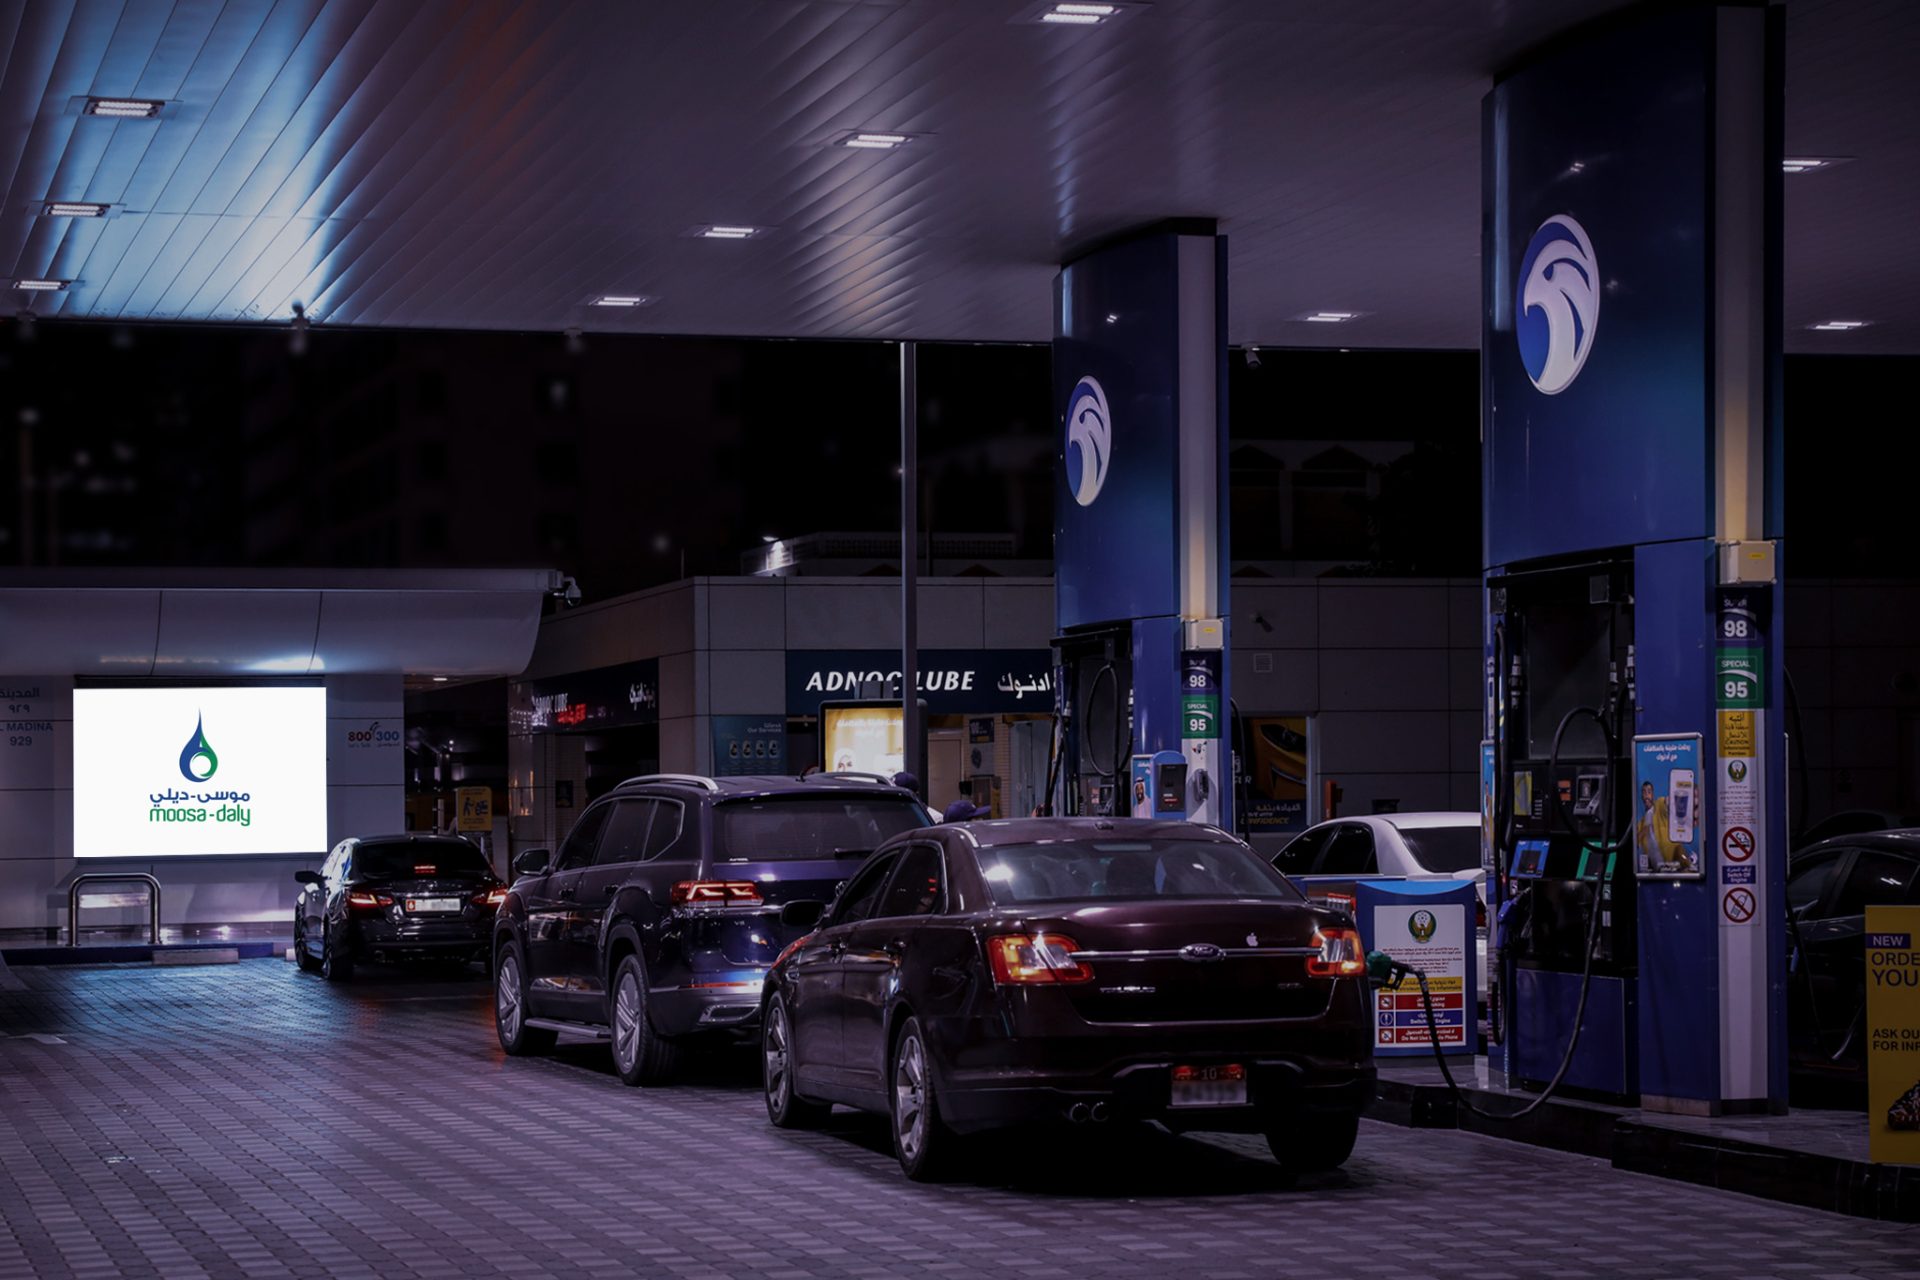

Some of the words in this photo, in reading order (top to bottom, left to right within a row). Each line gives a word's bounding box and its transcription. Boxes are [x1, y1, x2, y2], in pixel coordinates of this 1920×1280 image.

[1724, 620, 1748, 638] 98
[1721, 660, 1750, 668] SPECIAL
[997, 672, 1051, 700] ادنوك
[1189, 674, 1207, 688] 98
[1724, 681, 1748, 699] 95
[7, 722, 53, 731] MADINA
[1189, 718, 1207, 731] 95
[9, 735, 33, 746] 929
[347, 731, 373, 742] 800
[375, 730, 400, 742] 300
[149, 788, 251, 808] موسى-ديلي
[1872, 935, 1904, 947] NEW
[1872, 952, 1920, 966] ORDE
[1872, 969, 1918, 987] YOU
[1873, 1029, 1898, 1039] ASK
[1901, 1028, 1920, 1040] OU
[1873, 1041, 1899, 1051] FOR
[1201, 1067, 1217, 1080] 10
